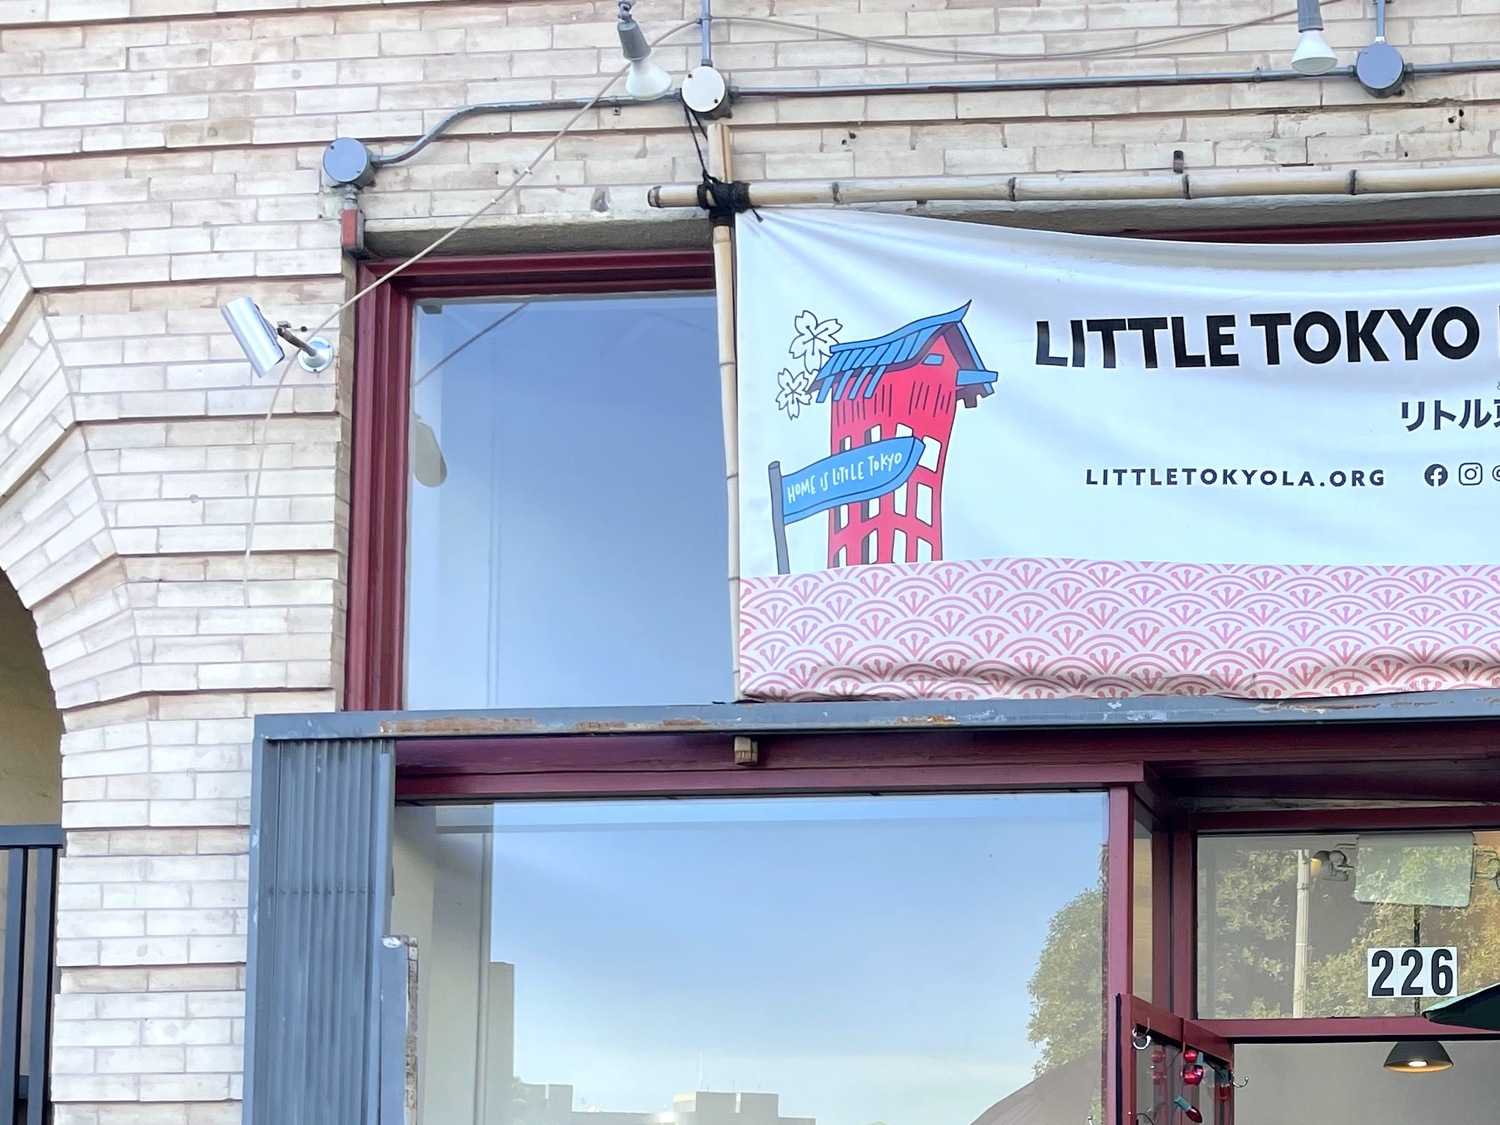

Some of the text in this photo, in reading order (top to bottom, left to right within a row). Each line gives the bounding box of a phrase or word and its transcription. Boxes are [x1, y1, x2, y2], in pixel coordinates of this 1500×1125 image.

[1036, 314, 1239, 369] LITTLE
[1249, 307, 1479, 366] TOKYO
[787, 452, 903, 503] HOME IS LITTLE TOKYO
[1086, 468, 1385, 487] LITTLETOKYOLA.ORG
[1371, 948, 1454, 997] 226
